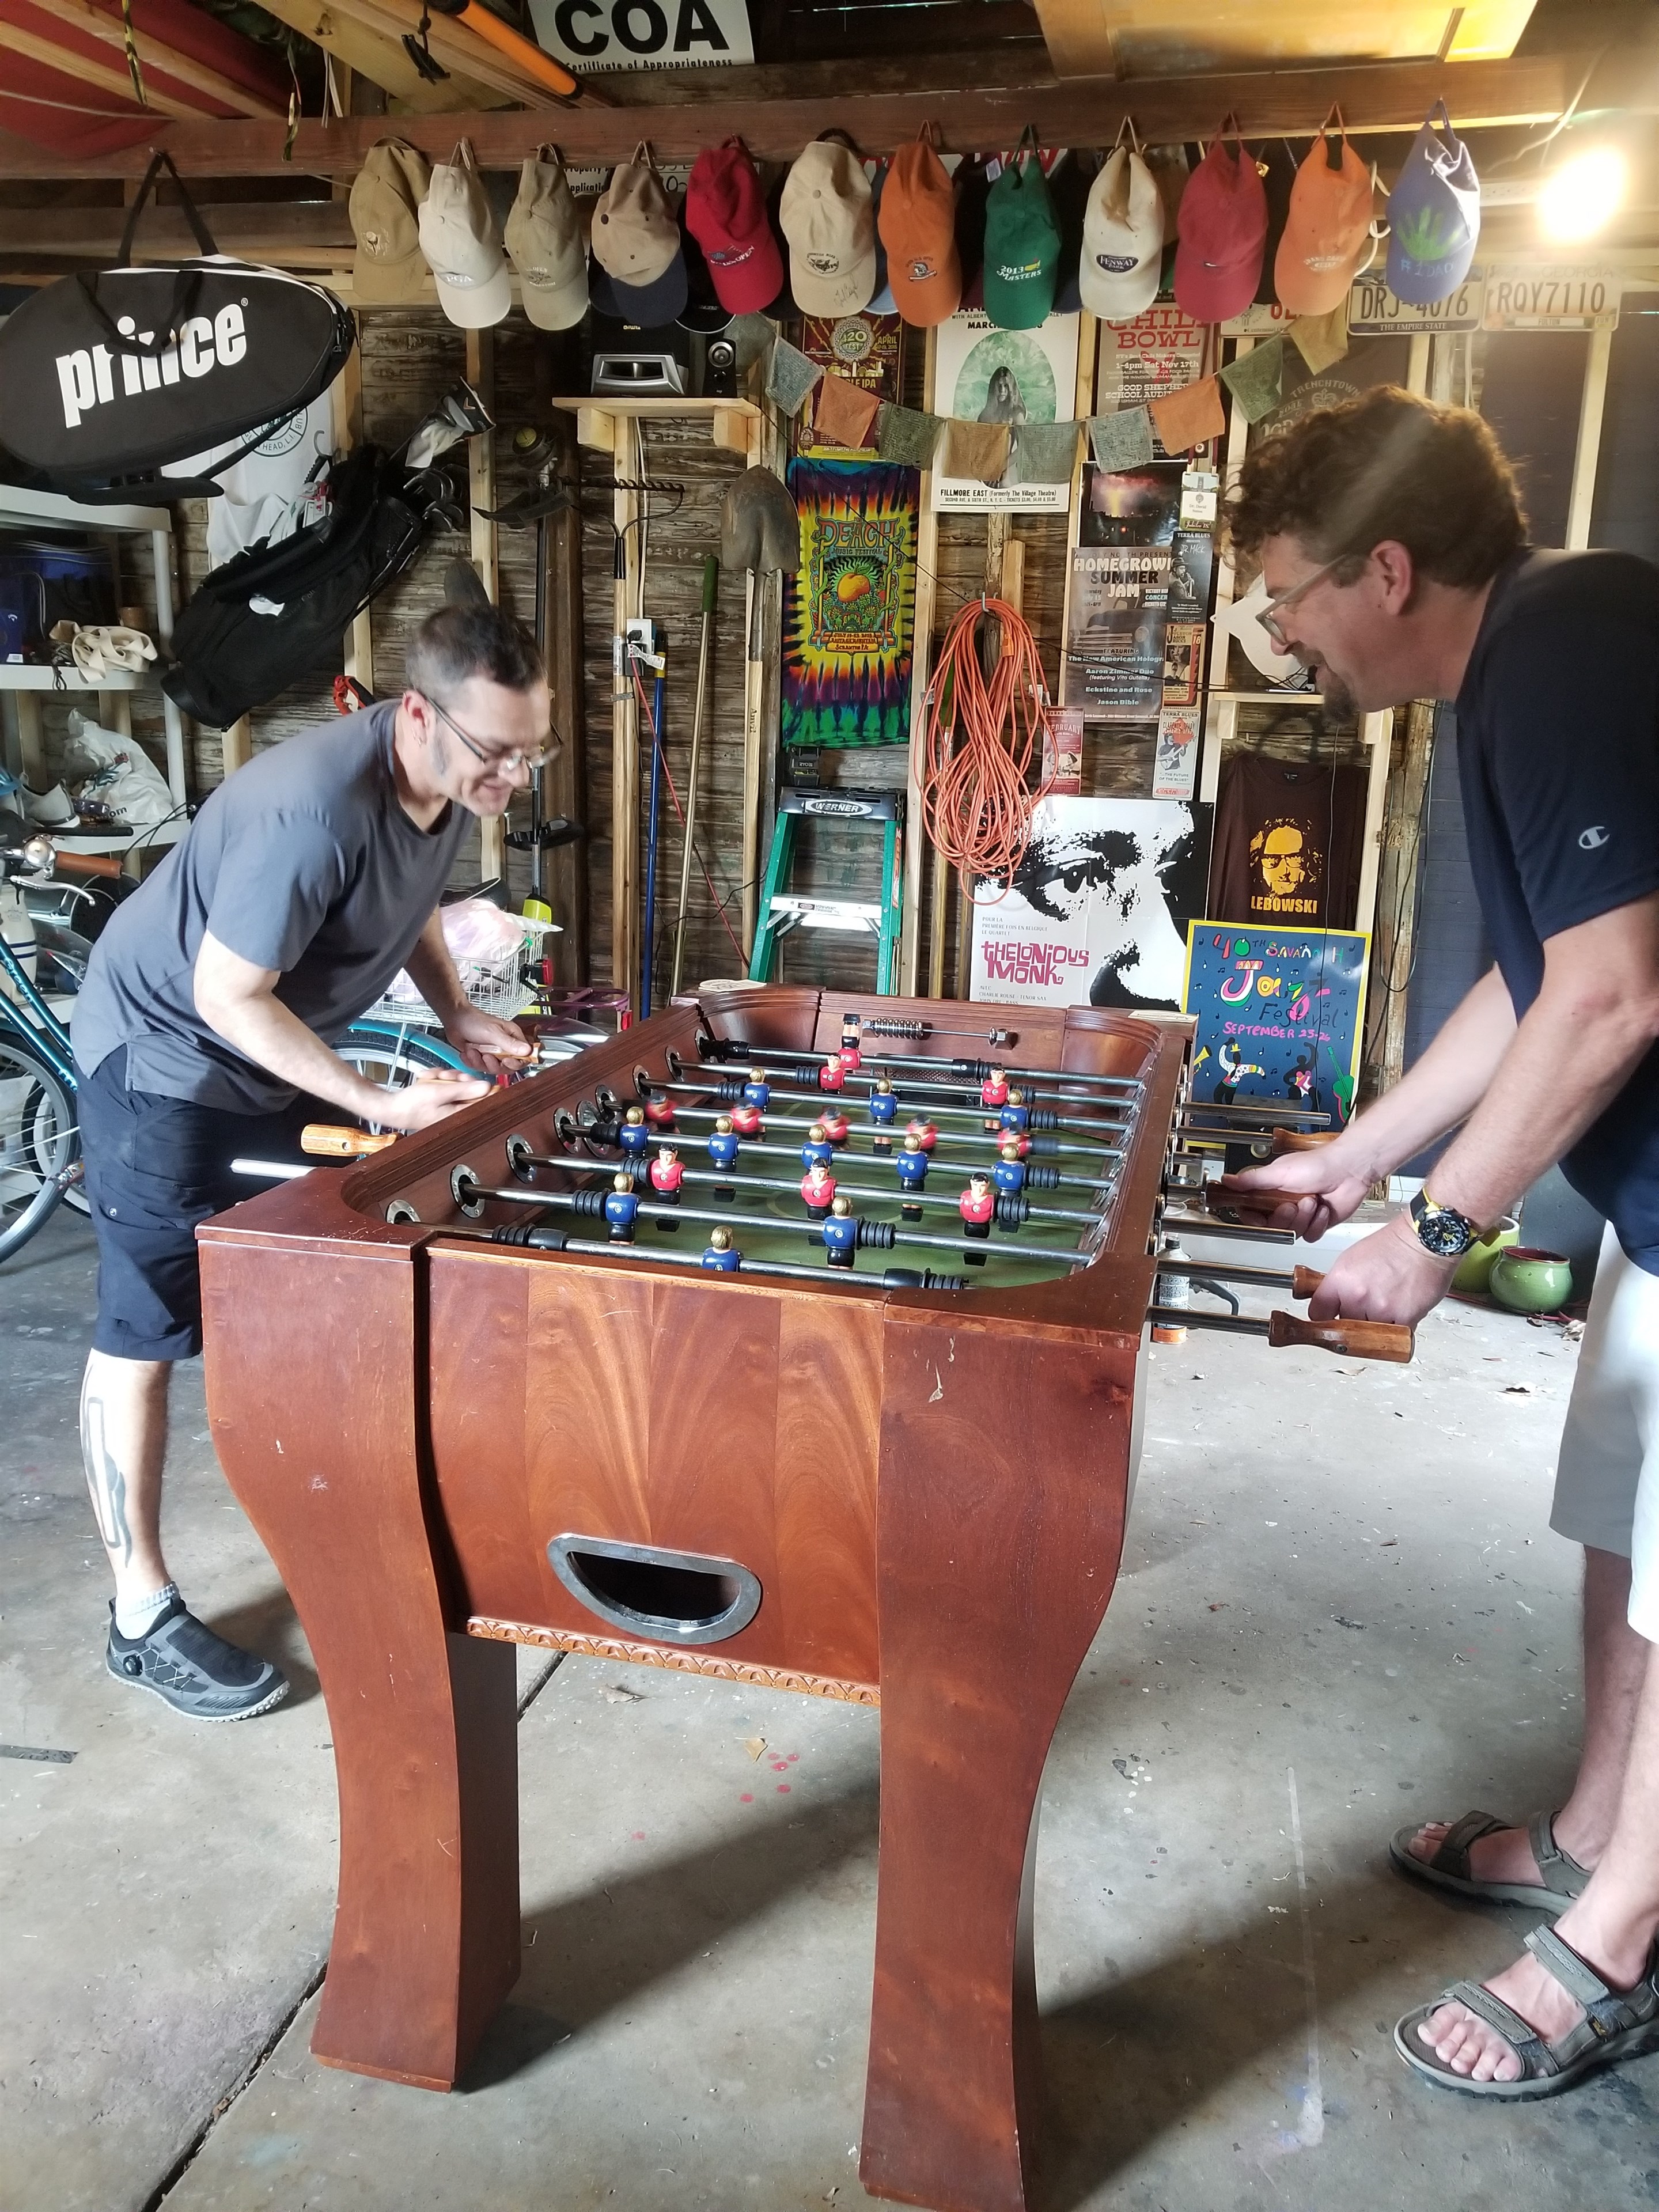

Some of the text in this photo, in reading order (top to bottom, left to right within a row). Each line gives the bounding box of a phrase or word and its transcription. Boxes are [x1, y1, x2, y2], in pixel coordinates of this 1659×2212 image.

[555, 0, 730, 56] COA
[627, 60, 638, 69] of
[643, 58, 733, 71] Appropriateness
[1100, 255, 1134, 266] FENWAY
[997, 270, 1041, 281] MASTERS
[1001, 266, 1024, 274] 2013
[1542, 266, 1613, 278] GEORGIA
[1497, 282, 1605, 313] RQY7110
[841, 331, 868, 342] 420
[1118, 331, 1200, 349] BOWL
[56, 304, 247, 428] prince
[862, 378, 876, 388] IPA
[1290, 380, 1361, 398] TRENCHTOWN
[817, 517, 900, 548] PEACH
[1090, 571, 1159, 585] SUMMER
[1107, 584, 1140, 597] JAM
[1192, 635, 1201, 645] 18
[815, 802, 859, 812] WERNER
[1251, 896, 1317, 914] LEBOWSKI
[987, 952, 1064, 986] MONK
[1259, 1003, 1339, 1028] Festival
[1222, 1021, 1294, 1037] SEPTEMBER
